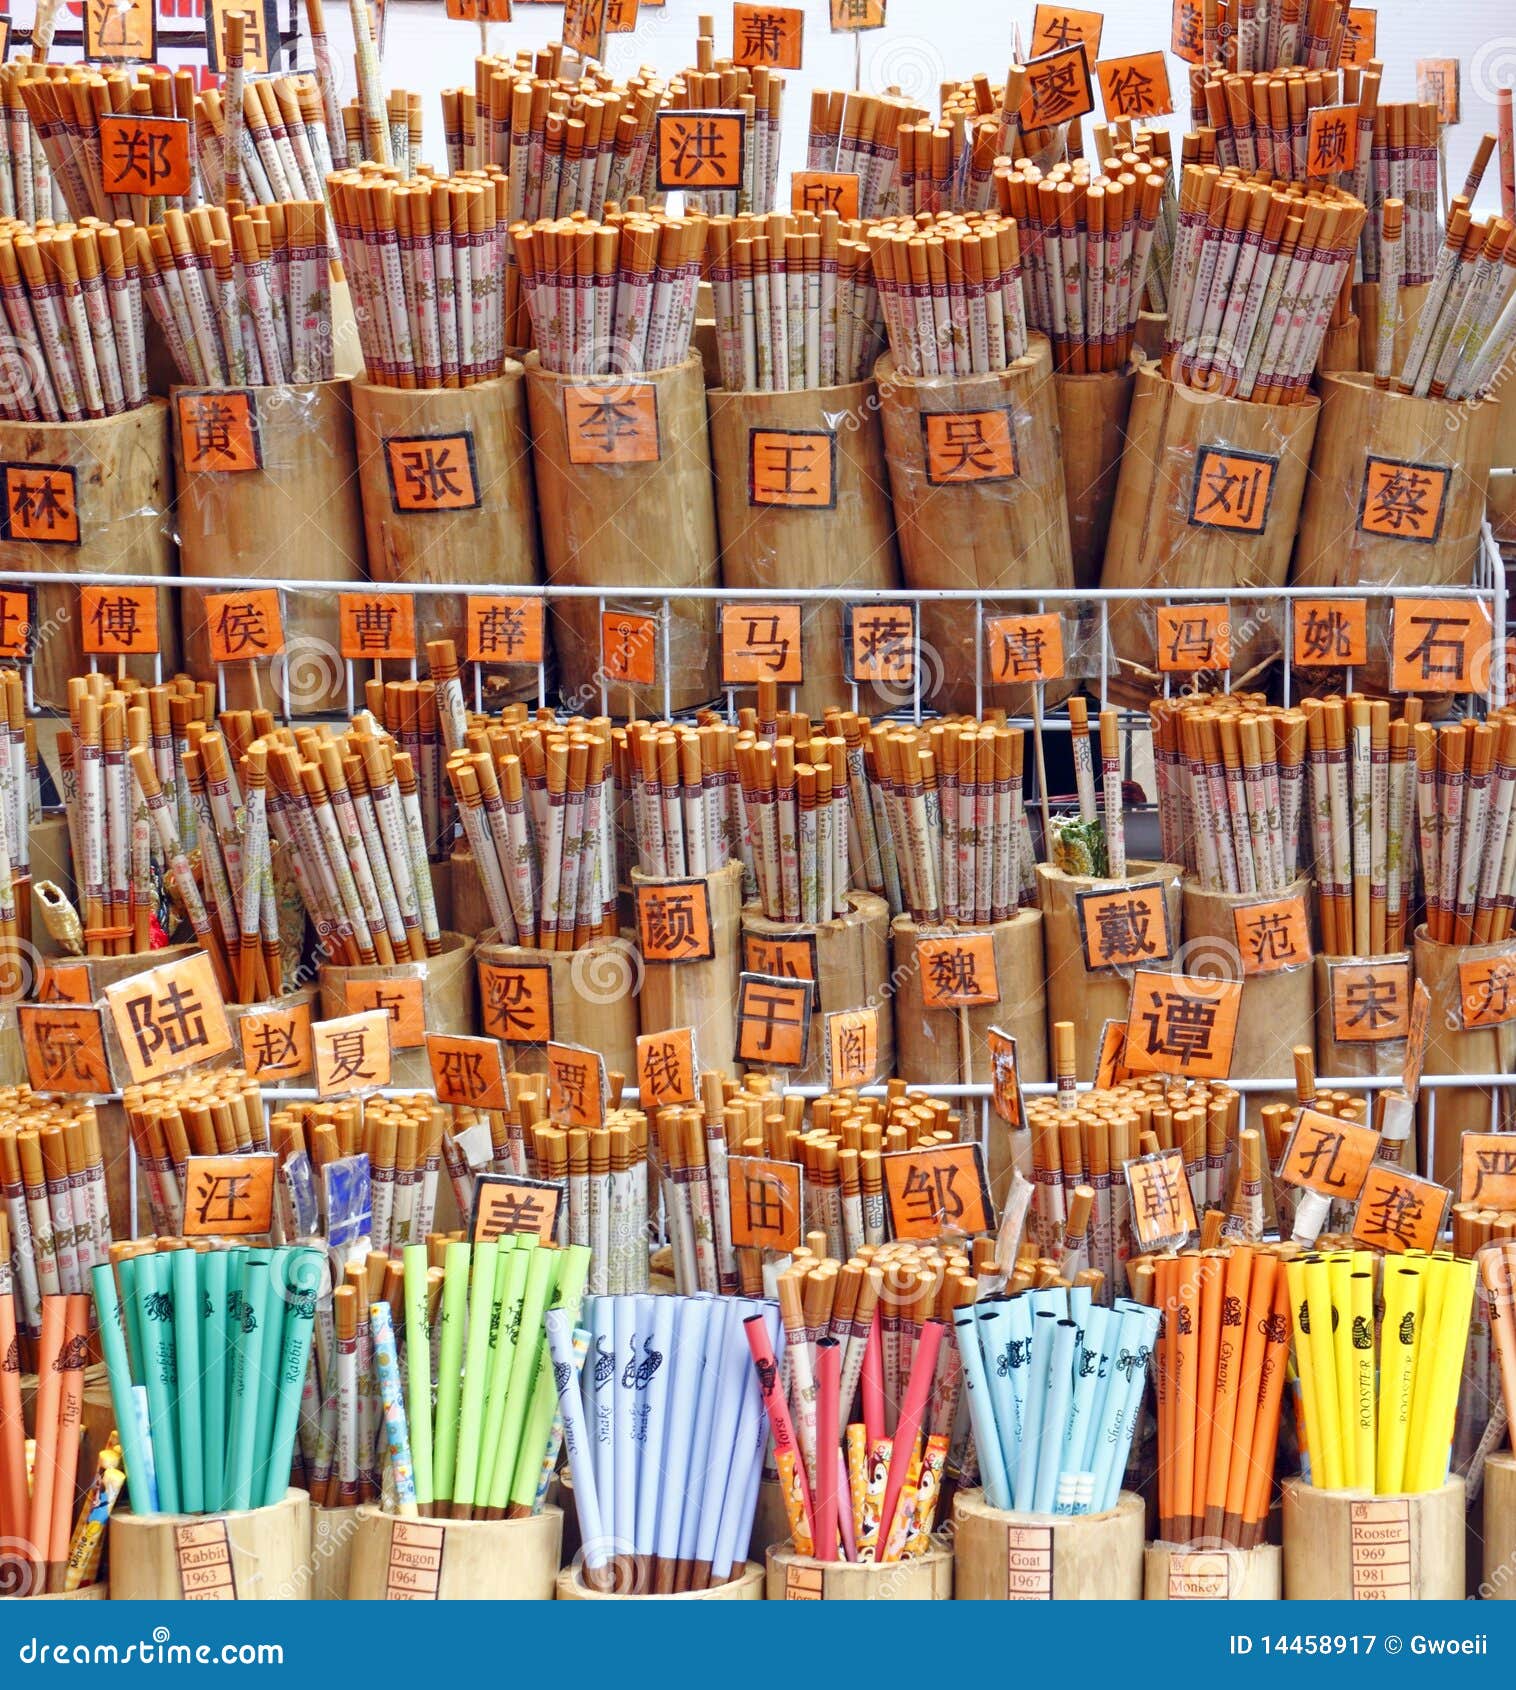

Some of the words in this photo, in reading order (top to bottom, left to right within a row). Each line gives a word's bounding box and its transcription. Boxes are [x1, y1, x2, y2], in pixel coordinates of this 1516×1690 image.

[92, 0, 143, 47] 江
[742, 13, 787, 62] 萧
[1030, 61, 1081, 123] 廖
[1108, 66, 1156, 115] 徐
[113, 129, 172, 187] 郑
[670, 121, 727, 180] 洪
[1313, 117, 1348, 169] 赖
[185, 402, 238, 462] 黄
[578, 395, 639, 455] 李
[938, 417, 998, 476] 吴
[400, 447, 463, 502] 张
[760, 443, 818, 496] 王
[1198, 462, 1264, 524] 刘
[11, 476, 69, 530] 林
[1373, 469, 1434, 531] 蔡
[90, 596, 142, 647] 傅
[216, 602, 269, 654] 侯
[349, 603, 398, 651] 曹
[476, 605, 527, 655] 薛
[736, 614, 792, 672] 马
[857, 616, 914, 672] 蒋
[1167, 618, 1214, 662] 冯
[1302, 606, 1352, 660] 姚
[1404, 615, 1471, 681] 石
[608, 627, 640, 673] 丁
[1000, 625, 1047, 678] 唐
[645, 893, 701, 951] 颜
[1096, 900, 1156, 958] 戴
[1247, 913, 1297, 963] 范
[484, 969, 535, 1032] 梁
[929, 948, 982, 1000] 魏
[126, 981, 210, 1068] 陆
[742, 994, 800, 1050] 于
[1142, 991, 1221, 1067] 谭
[1345, 975, 1400, 1030] 宋
[34, 1021, 94, 1081] 阮
[252, 1021, 301, 1075] 赵
[325, 1026, 377, 1086] 夏
[437, 1051, 487, 1099] 邵
[643, 1042, 682, 1097] 钱
[555, 1060, 587, 1117] 贾
[1299, 1127, 1348, 1189] 孔
[196, 1171, 254, 1225] 汪
[746, 1174, 784, 1235] 田
[901, 1164, 965, 1225] 邹
[1137, 1164, 1180, 1227] 韩
[1363, 1184, 1424, 1249] 龚
[286, 1339, 303, 1385] Rabbit
[63, 1391, 80, 1428] Tiger
[1360, 1360, 1372, 1430] ROOSTER
[599, 1404, 613, 1445] Snake
[1108, 1410, 1124, 1444] Sheep
[182, 1547, 226, 1564] Rabbit
[392, 1548, 435, 1567] Dragon
[1010, 1553, 1040, 1567] Goat
[1354, 1527, 1402, 1540] Rooster
[1356, 1548, 1386, 1560] 1969
[186, 1570, 217, 1586] 1963
[391, 1570, 417, 1585] 1964
[1011, 1575, 1040, 1587] 1967
[1171, 1579, 1220, 1593] Monkey
[1356, 1569, 1384, 1581] 1981
